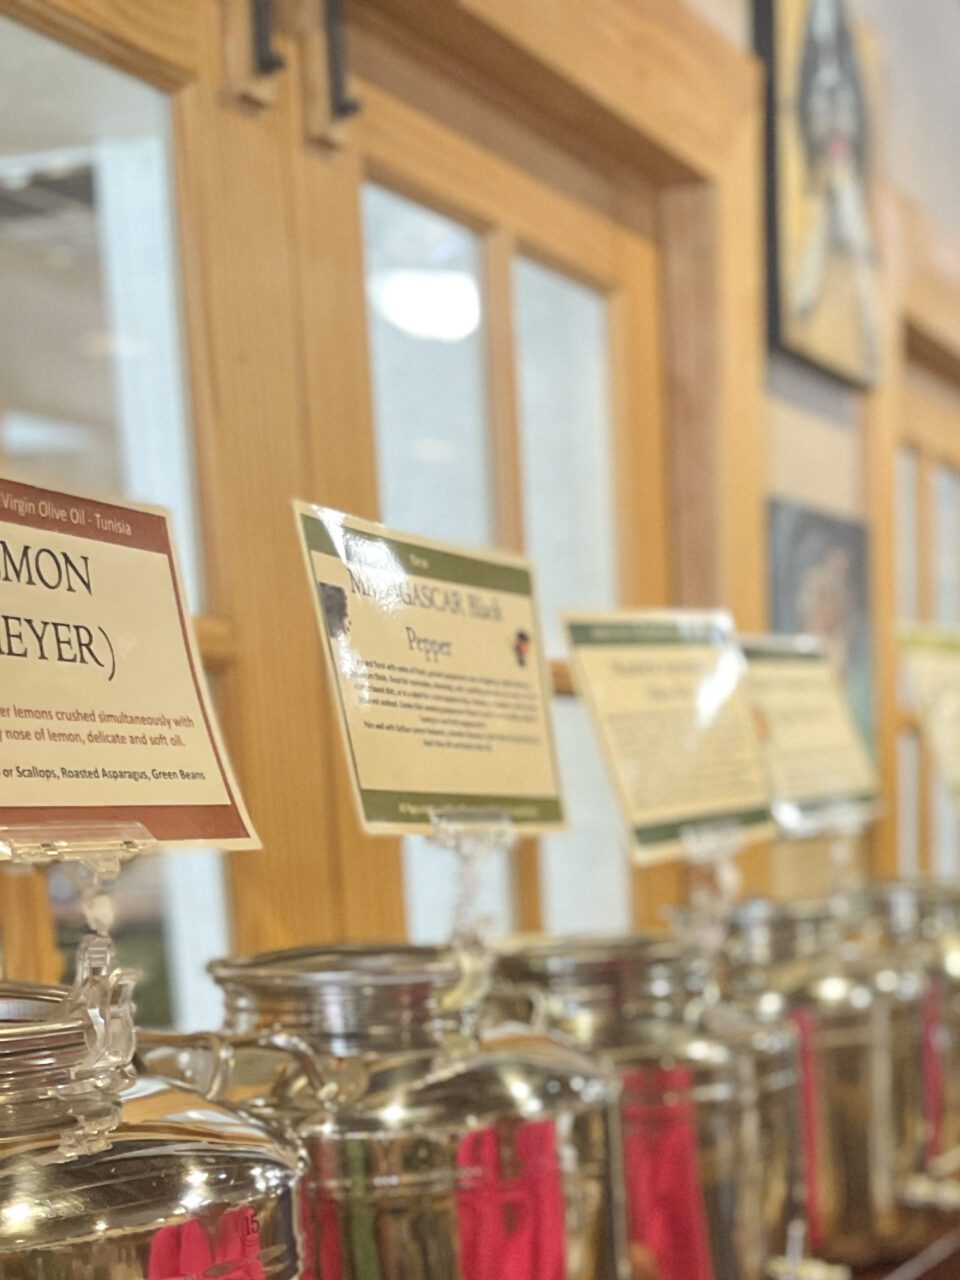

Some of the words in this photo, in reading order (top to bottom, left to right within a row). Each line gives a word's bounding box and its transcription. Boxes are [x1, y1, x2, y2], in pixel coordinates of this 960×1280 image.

[0, 493, 36, 517] Virgin
[39, 501, 68, 522] Olive
[70, 508, 86, 526] Oil
[94, 513, 132, 536] Tunisia
[0, 539, 93, 596] MON
[0, 614, 115, 682] EYER)
[13, 703, 54, 721] lemons
[55, 708, 96, 723] crushed
[98, 710, 171, 730] simultaneously
[173, 714, 195, 728] with
[5, 729, 33, 741] nose
[34, 727, 46, 741] of
[47, 728, 86, 746] lemon,
[87, 729, 127, 744] delicate
[129, 732, 148, 745] and
[149, 732, 169, 746] soft
[2, 768, 13, 778] or
[15, 766, 60, 780] Scallops,
[60, 767, 100, 779] Roasted
[101, 767, 151, 782] Asparagus,
[151, 768, 179, 780] Green
[179, 769, 206, 780] Beans
